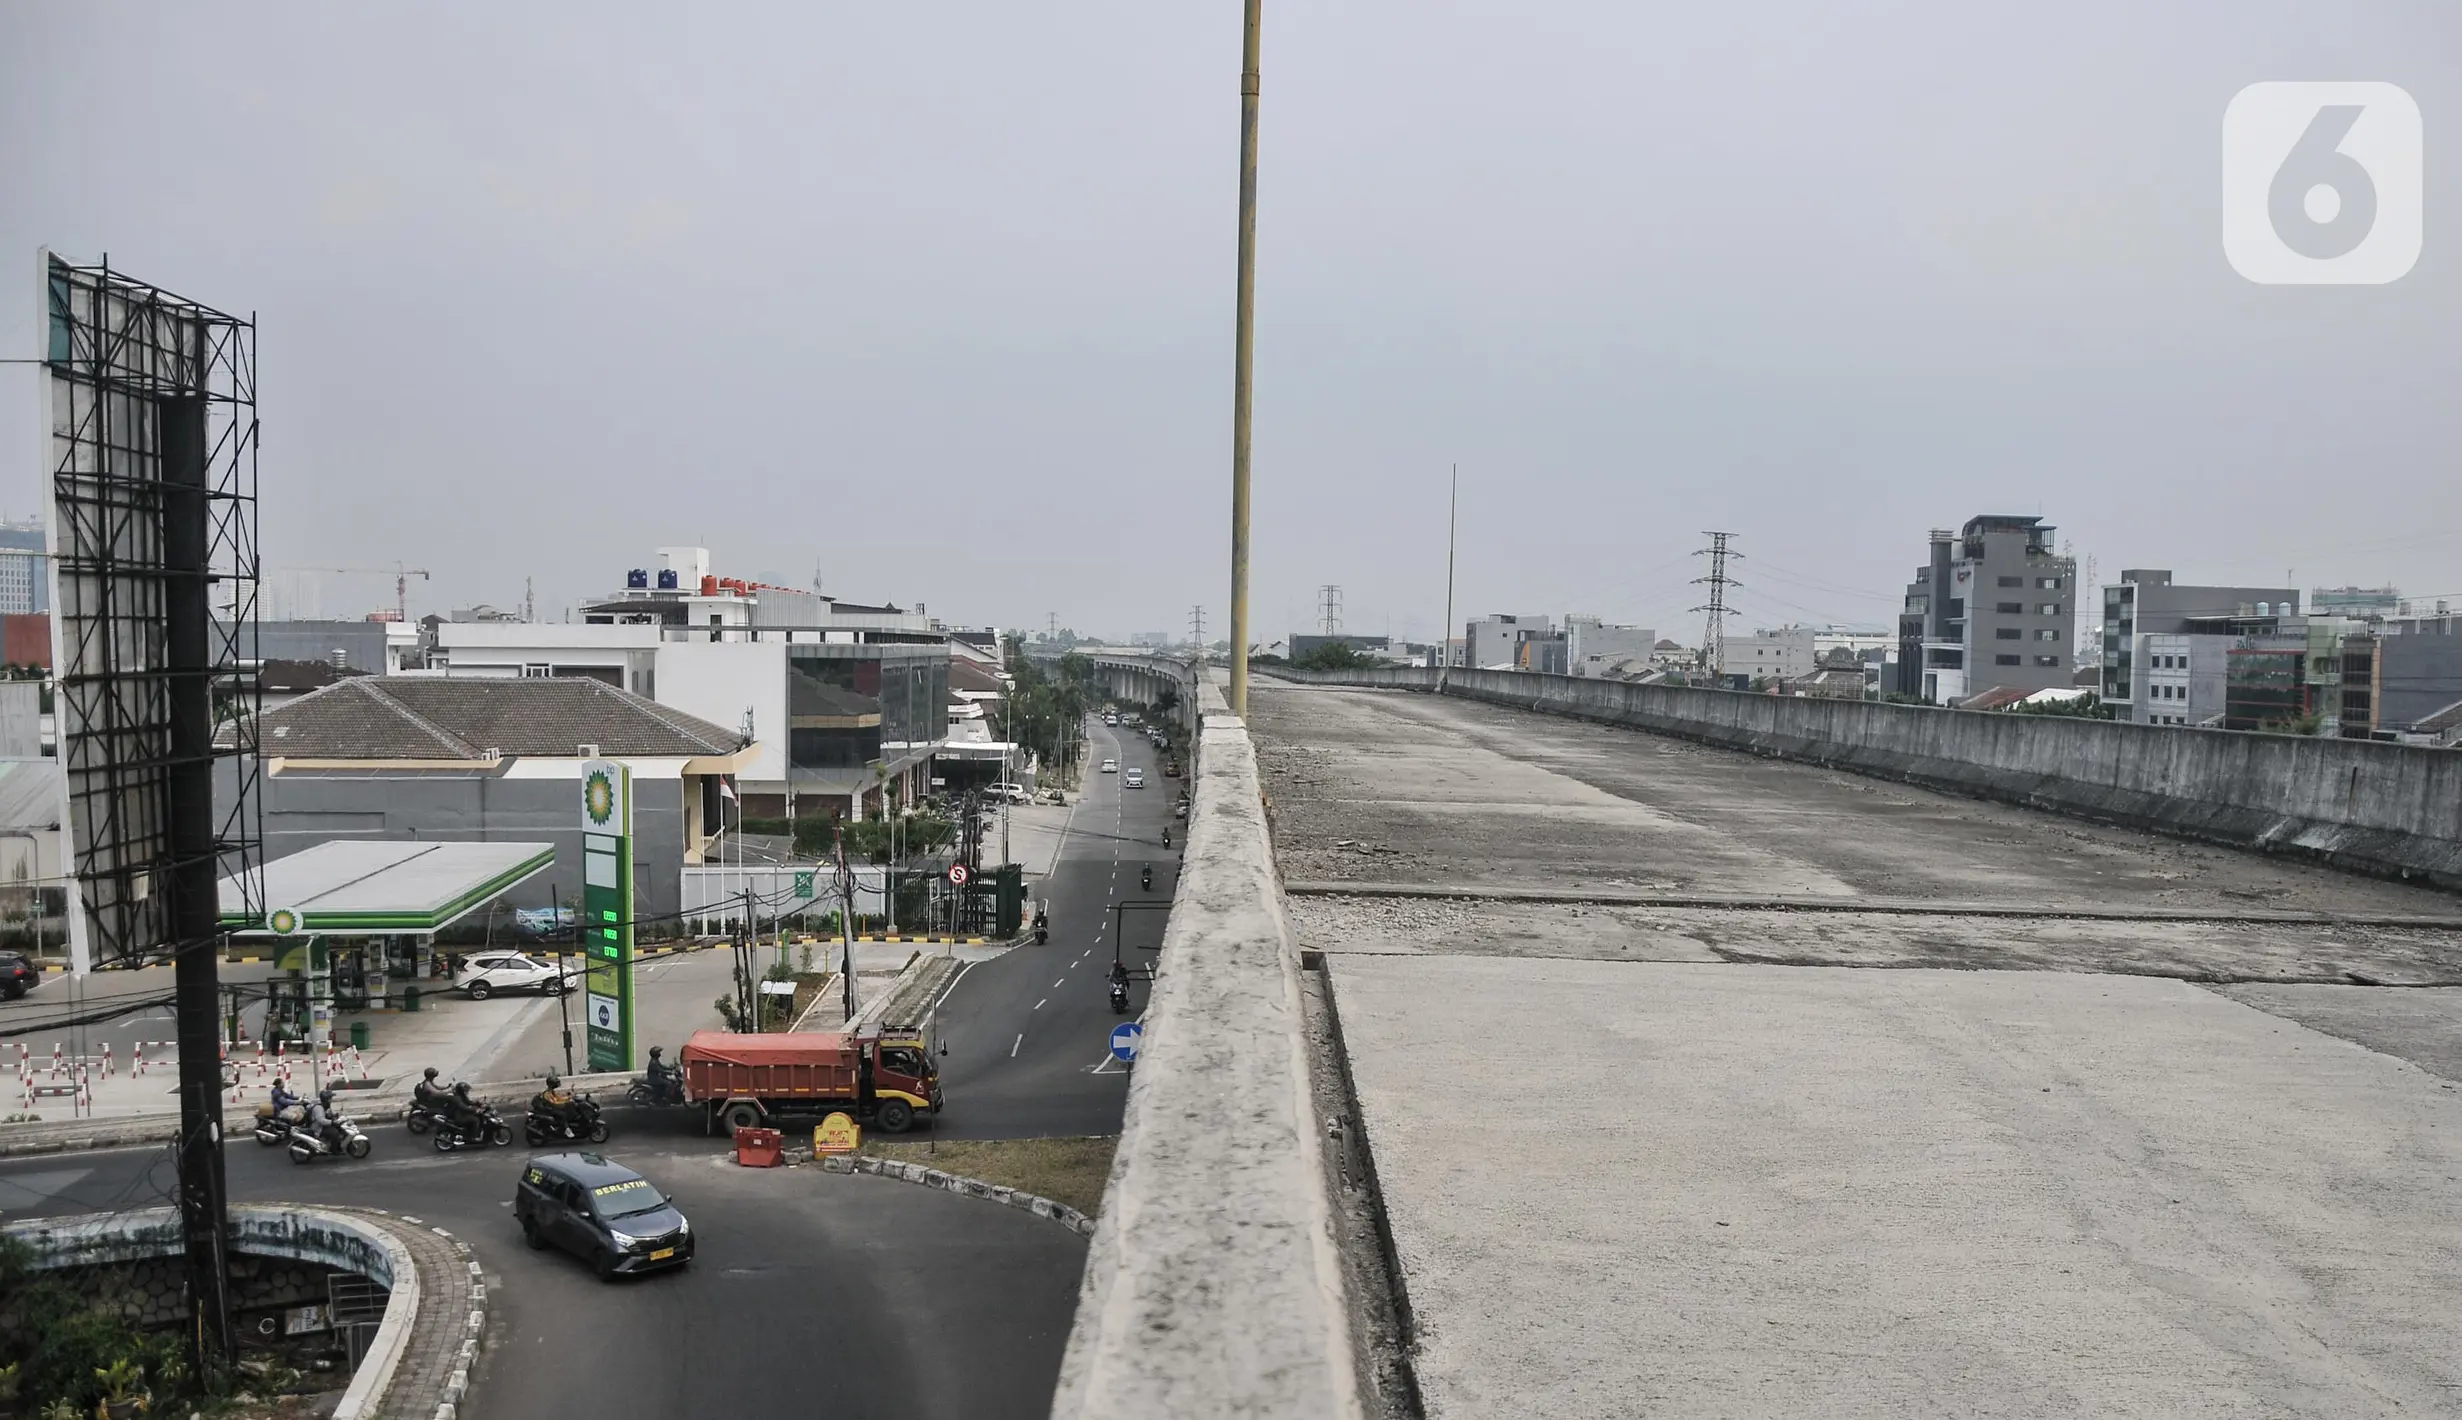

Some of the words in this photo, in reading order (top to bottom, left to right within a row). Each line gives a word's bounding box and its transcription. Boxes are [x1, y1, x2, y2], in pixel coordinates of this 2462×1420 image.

[606, 765, 615, 775] bp
[953, 869, 963, 881] S
[595, 1180, 648, 1196] BERLATIH
